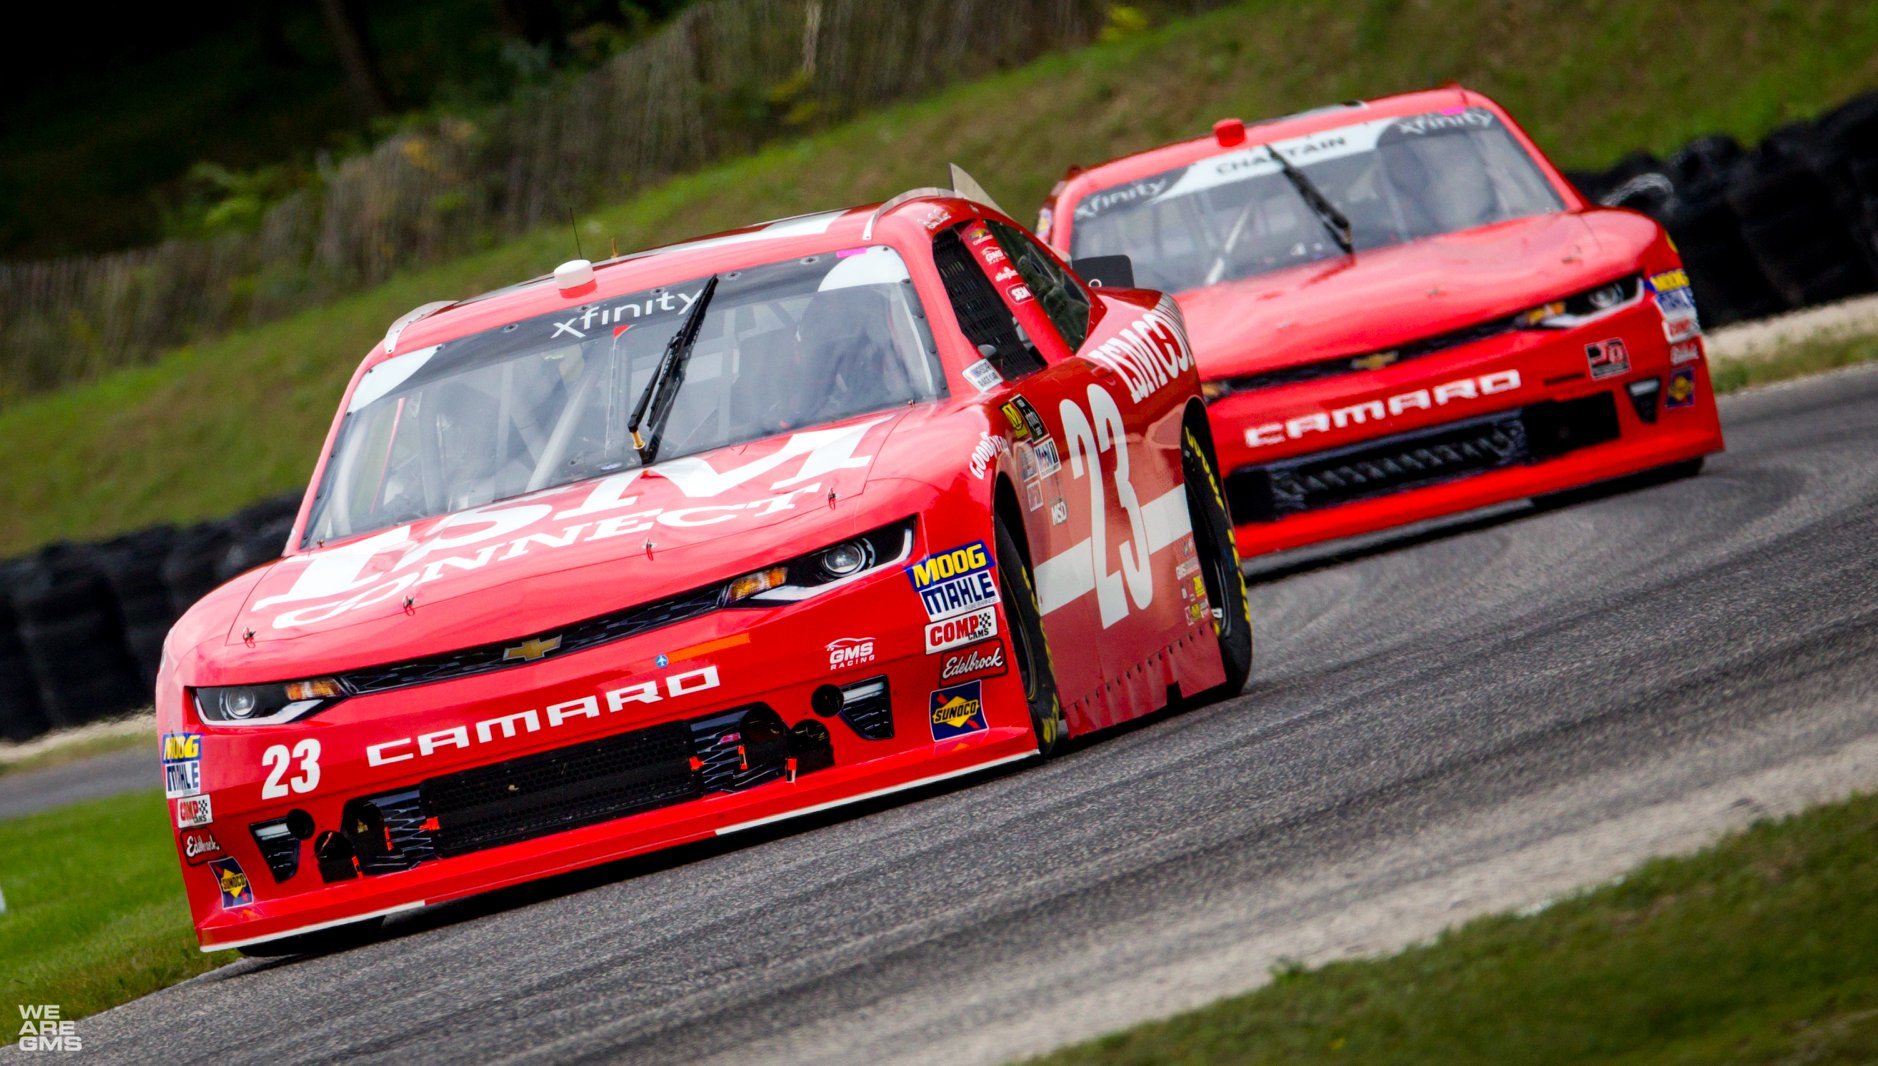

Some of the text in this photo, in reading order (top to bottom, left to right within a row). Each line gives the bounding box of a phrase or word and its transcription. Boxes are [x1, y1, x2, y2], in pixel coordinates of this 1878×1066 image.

[1216, 136, 1346, 174] CHATAIN
[551, 289, 703, 339] xfinity
[1245, 369, 1522, 447] CAMARO
[1059, 383, 1153, 630] 23
[912, 544, 988, 588] MOOG
[922, 572, 996, 616] MAHLE
[930, 615, 979, 647] COMP
[968, 628, 989, 641] CAMS
[829, 641, 874, 664] GMS
[830, 655, 875, 671] RACING
[942, 648, 1004, 679] Edelbrock
[366, 665, 720, 767] CAMARO
[934, 701, 978, 723] SUNOCO
[261, 738, 322, 800] 23
